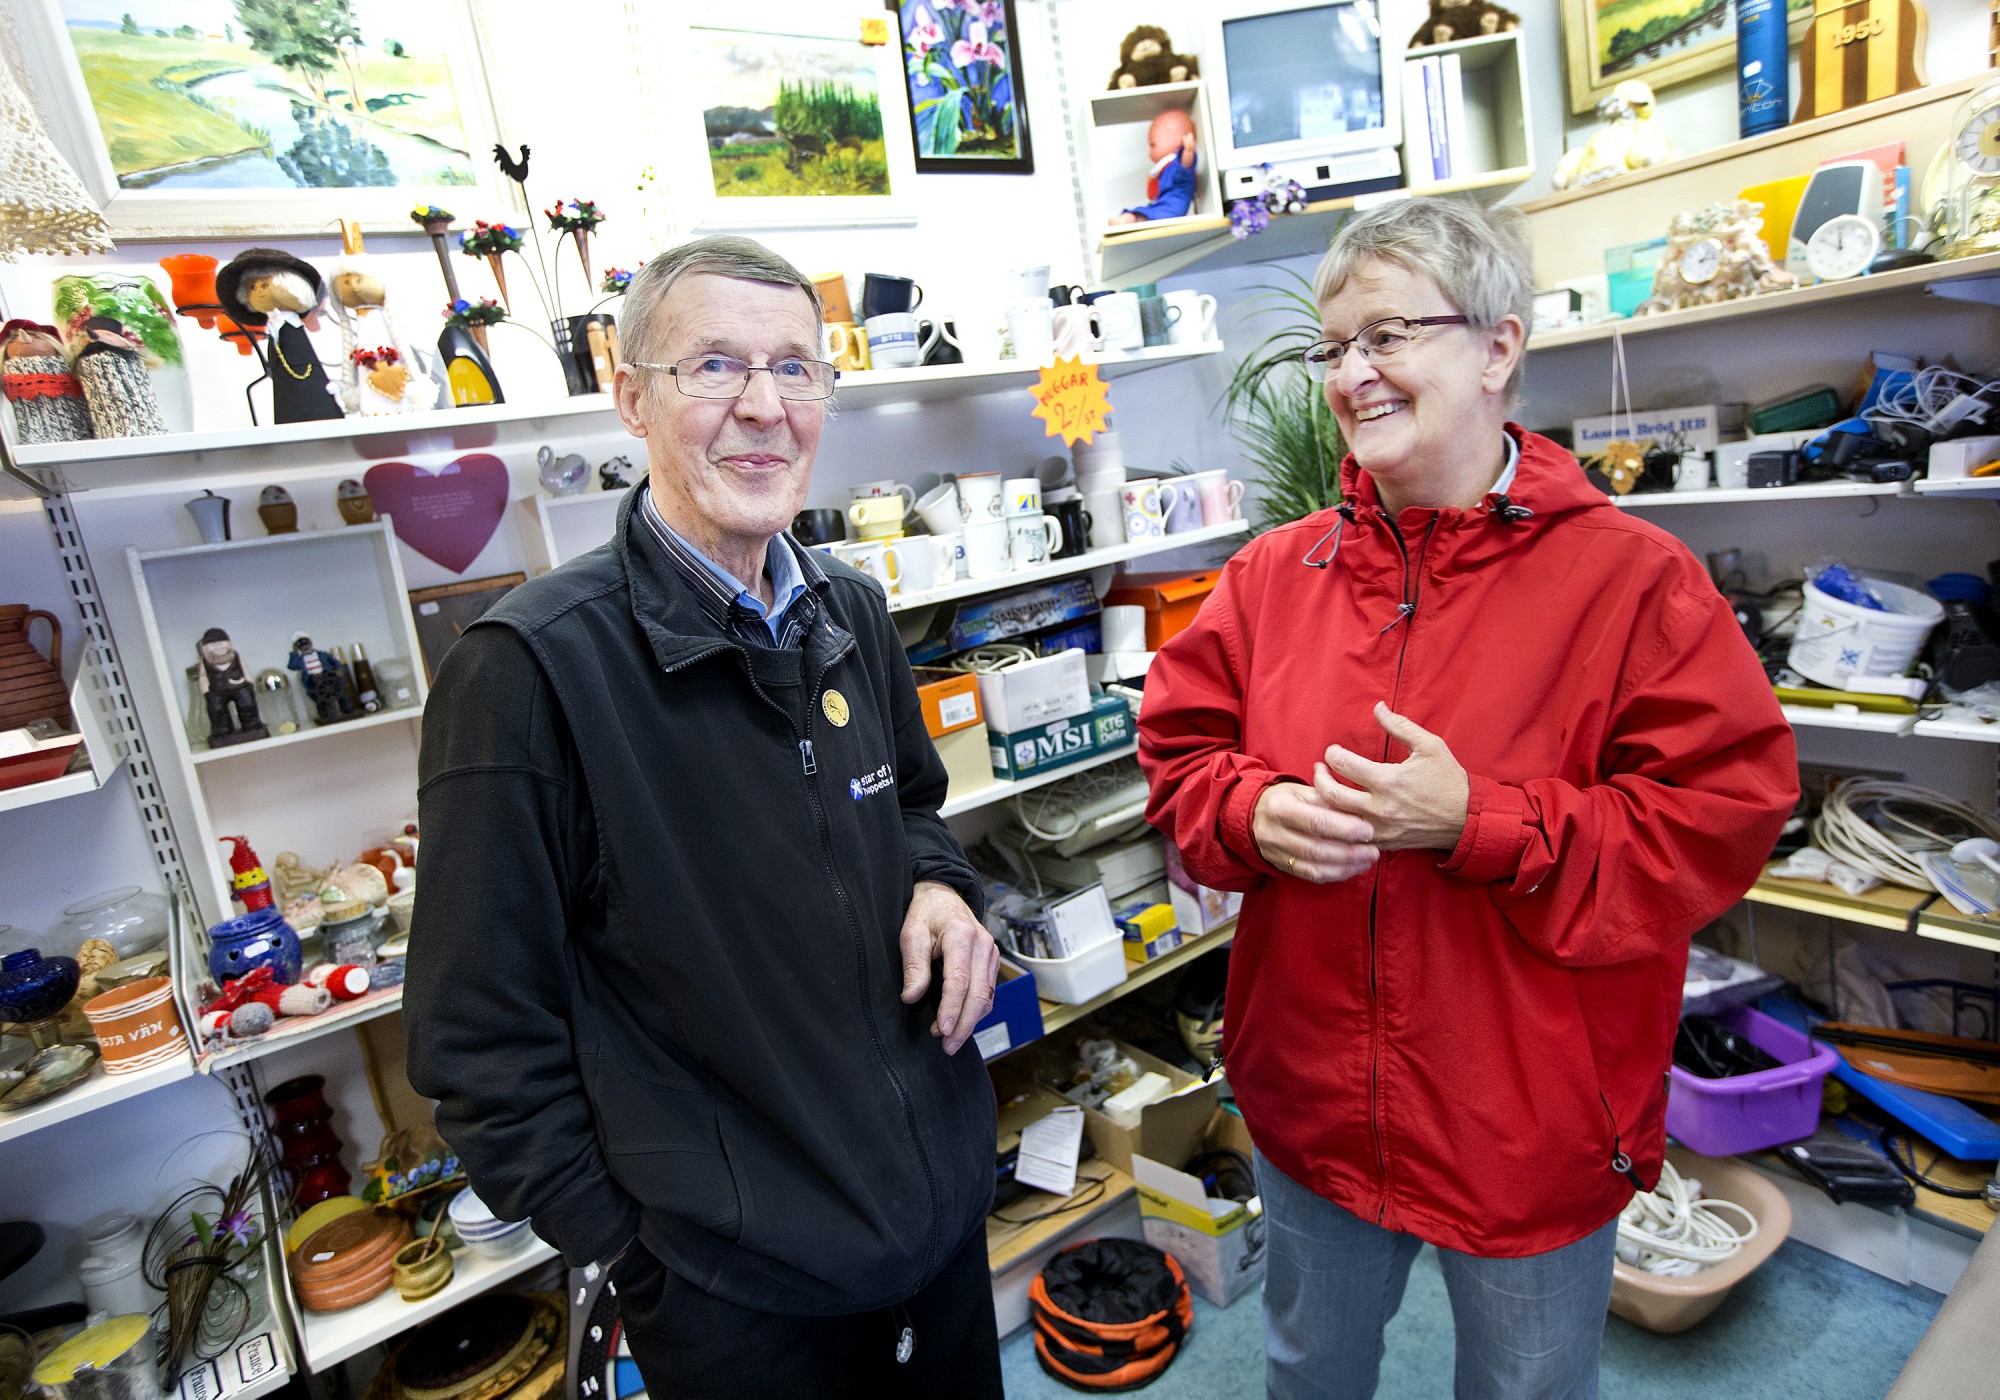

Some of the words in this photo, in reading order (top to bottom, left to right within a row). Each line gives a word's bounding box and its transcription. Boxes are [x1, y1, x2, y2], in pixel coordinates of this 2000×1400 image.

[1832, 18, 1885, 48] 1950
[1036, 723, 1092, 760] MSI
[861, 772, 875, 786] star
[877, 765, 887, 778] of
[98, 1034, 125, 1047] STA
[128, 1021, 163, 1041] VÄN
[590, 1325, 603, 1343] 9
[247, 1340, 264, 1375] France
[581, 1376, 599, 1397] 14
